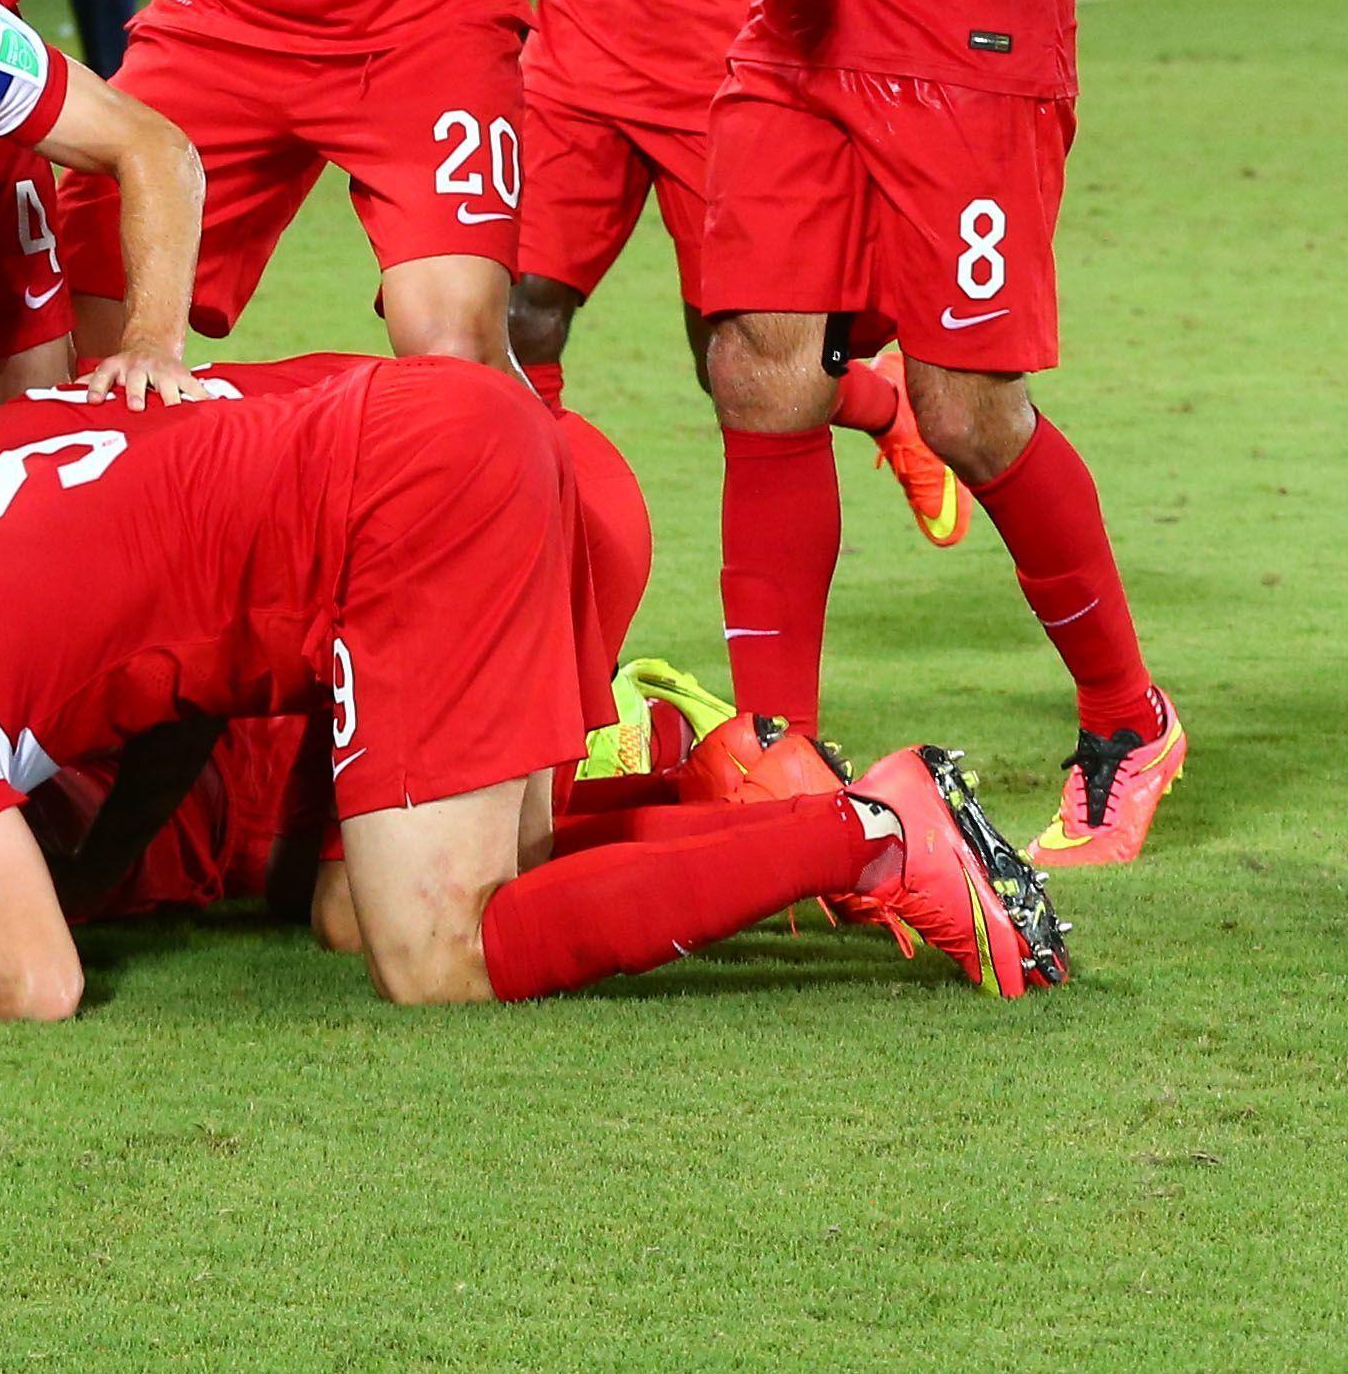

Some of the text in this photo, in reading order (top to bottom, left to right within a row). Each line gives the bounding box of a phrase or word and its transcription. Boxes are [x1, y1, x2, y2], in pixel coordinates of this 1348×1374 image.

[433, 109, 521, 210] 20
[15, 179, 61, 273] 4
[957, 198, 1006, 299] 8
[333, 637, 357, 748] 9
